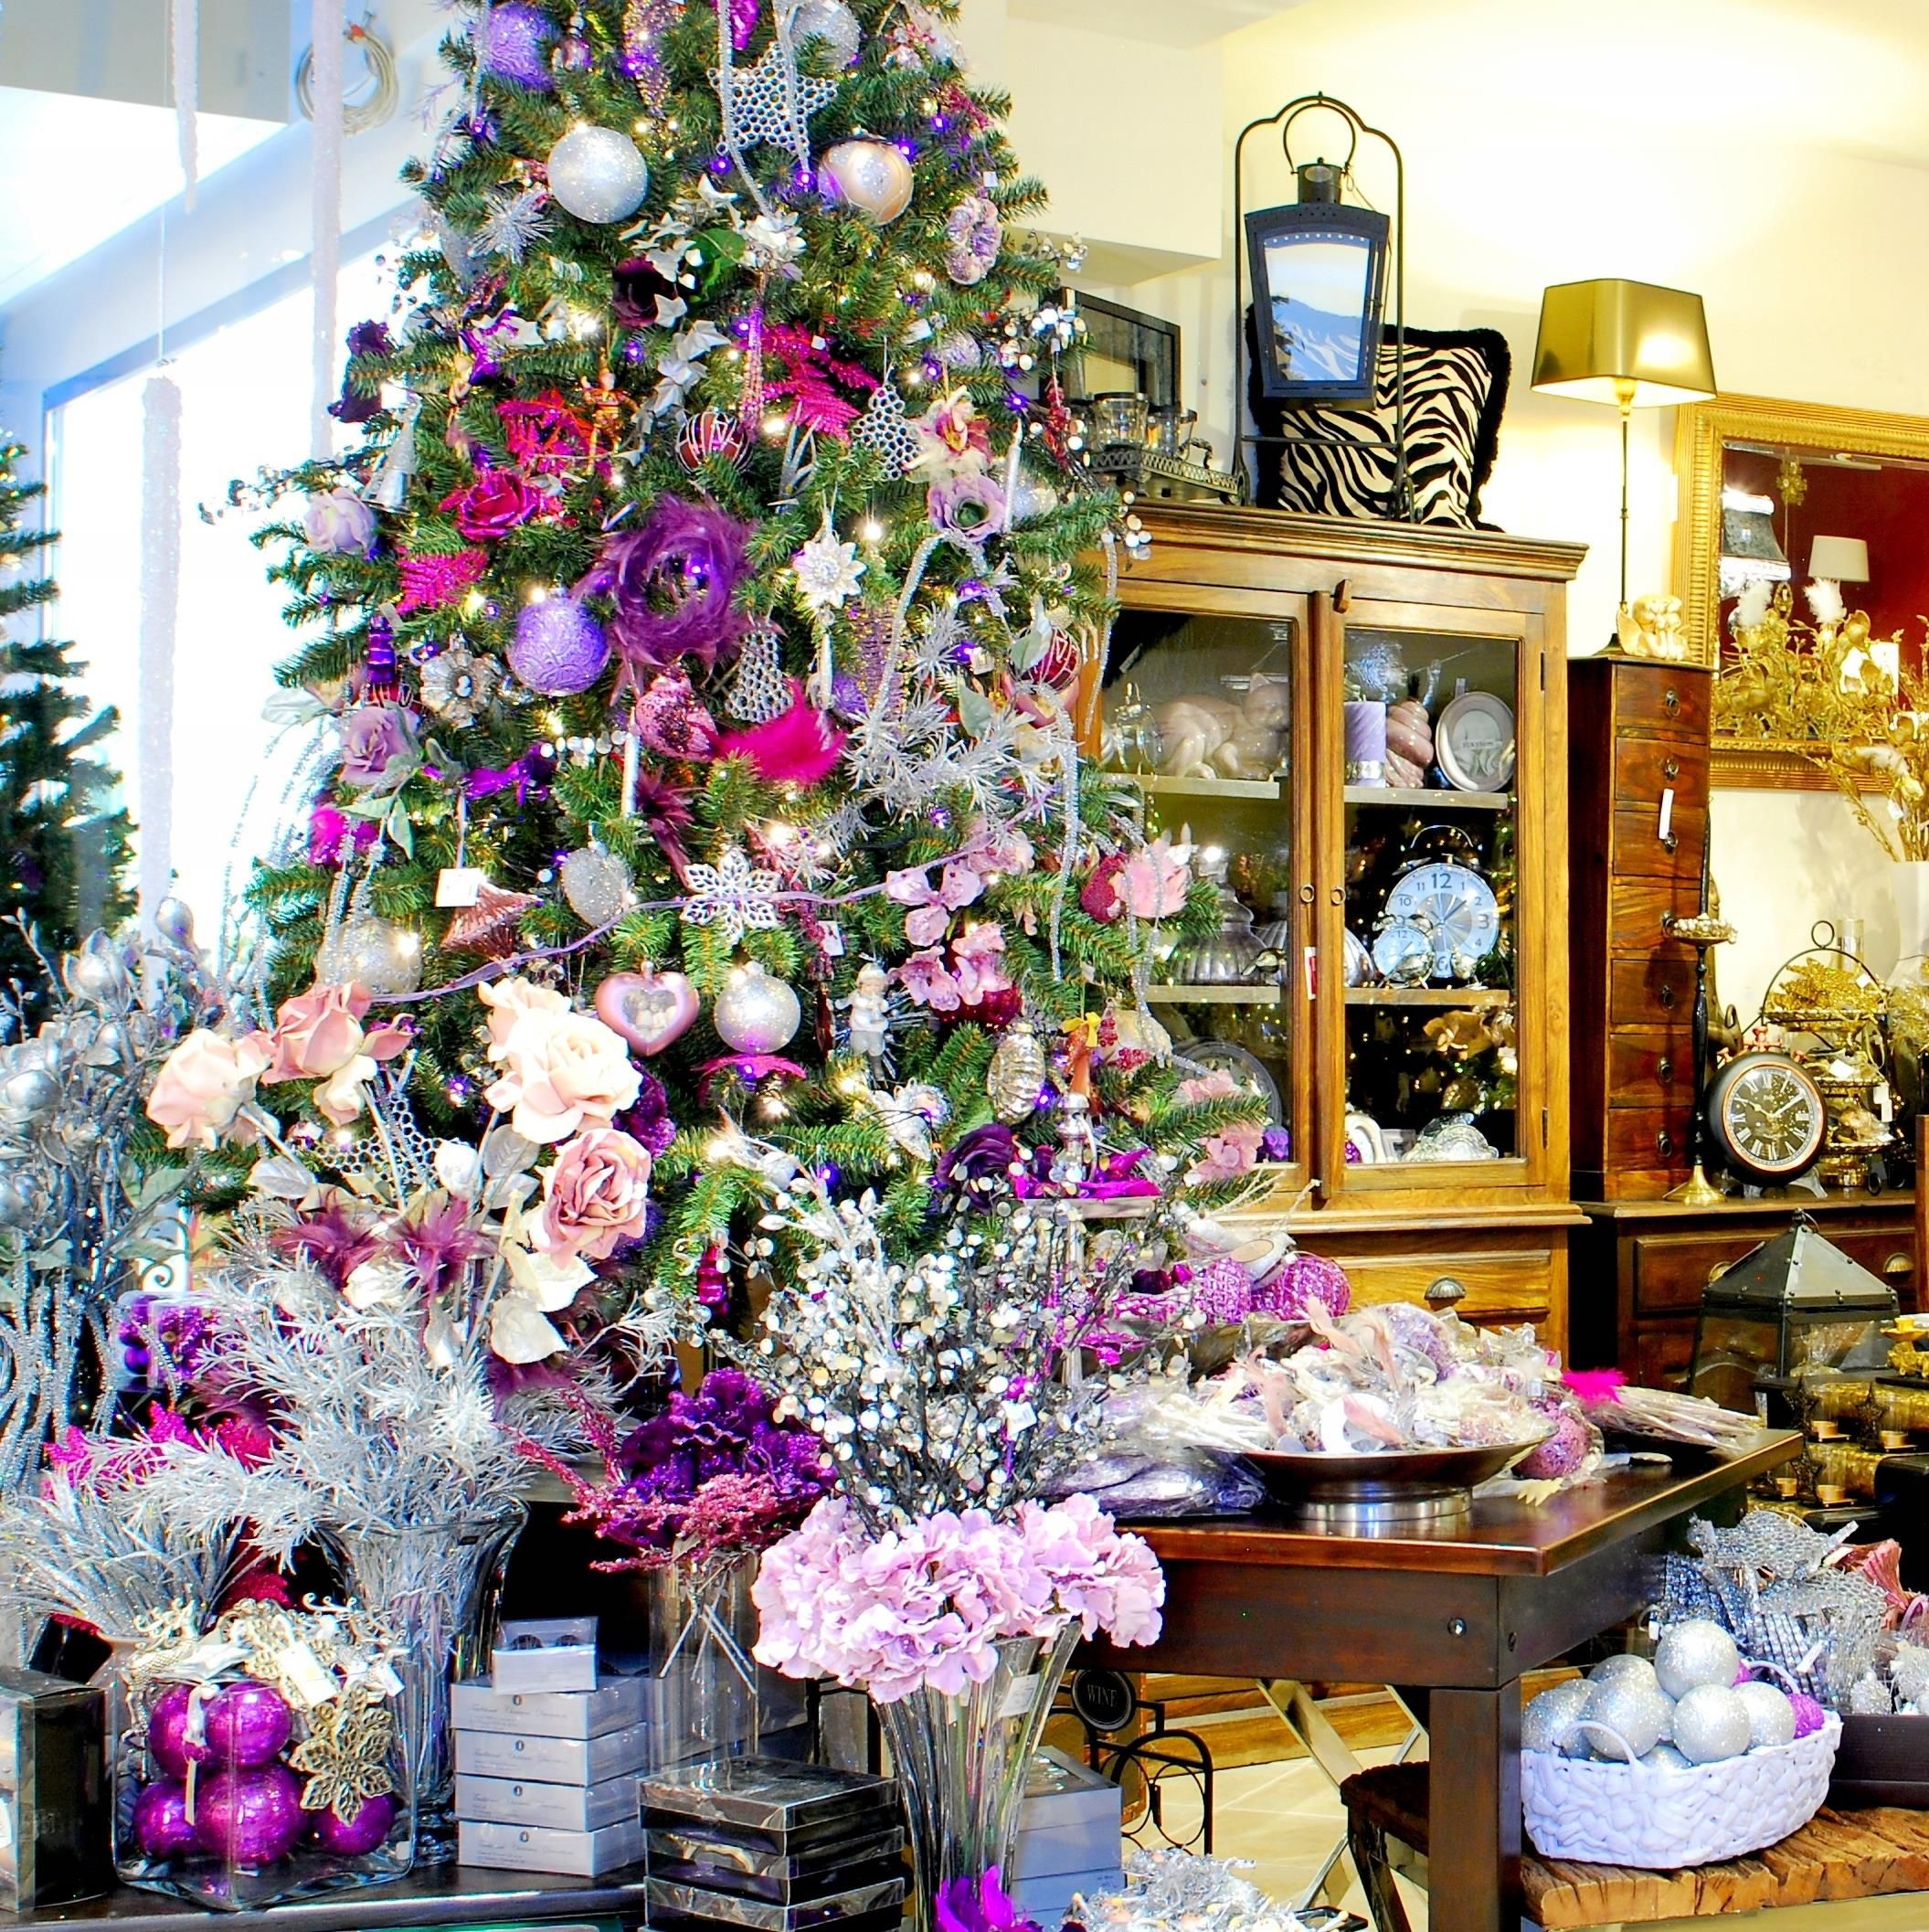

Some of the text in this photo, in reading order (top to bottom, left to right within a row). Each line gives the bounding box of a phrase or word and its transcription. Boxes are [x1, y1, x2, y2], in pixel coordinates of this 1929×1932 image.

[1430, 873, 1452, 889] 12
[1416, 882, 1426, 891] 11
[1461, 882, 1466, 891] 1
[1399, 897, 1412, 907] 10
[1474, 897, 1482, 906] 2
[1478, 914, 1489, 929] 3
